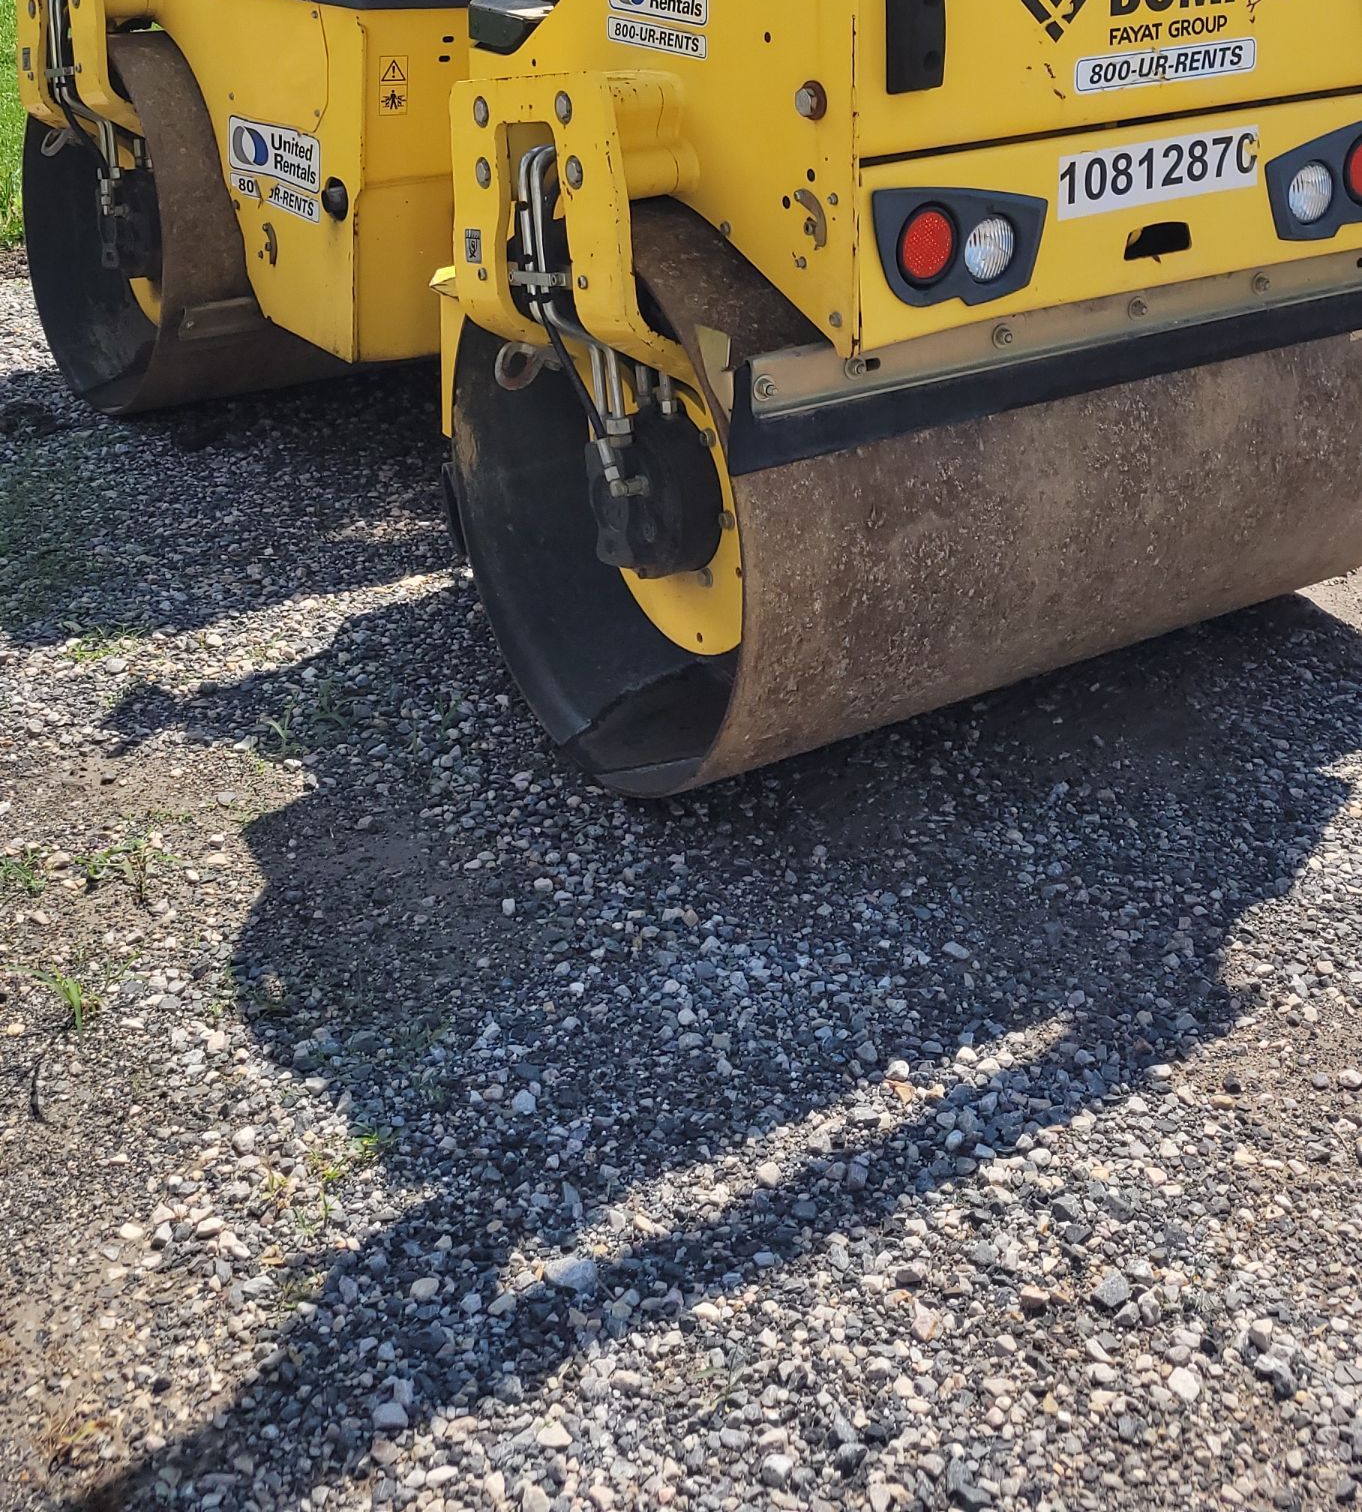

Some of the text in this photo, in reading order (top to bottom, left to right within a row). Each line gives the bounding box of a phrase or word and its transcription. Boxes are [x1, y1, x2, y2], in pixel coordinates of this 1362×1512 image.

[614, 22, 699, 52] 800-UR-RENTS
[1109, 15, 1228, 46] FAYAT GROUP
[1089, 45, 1243, 85] 800-UR-RENTS
[271, 133, 313, 162] United
[274, 153, 316, 185] Rentals
